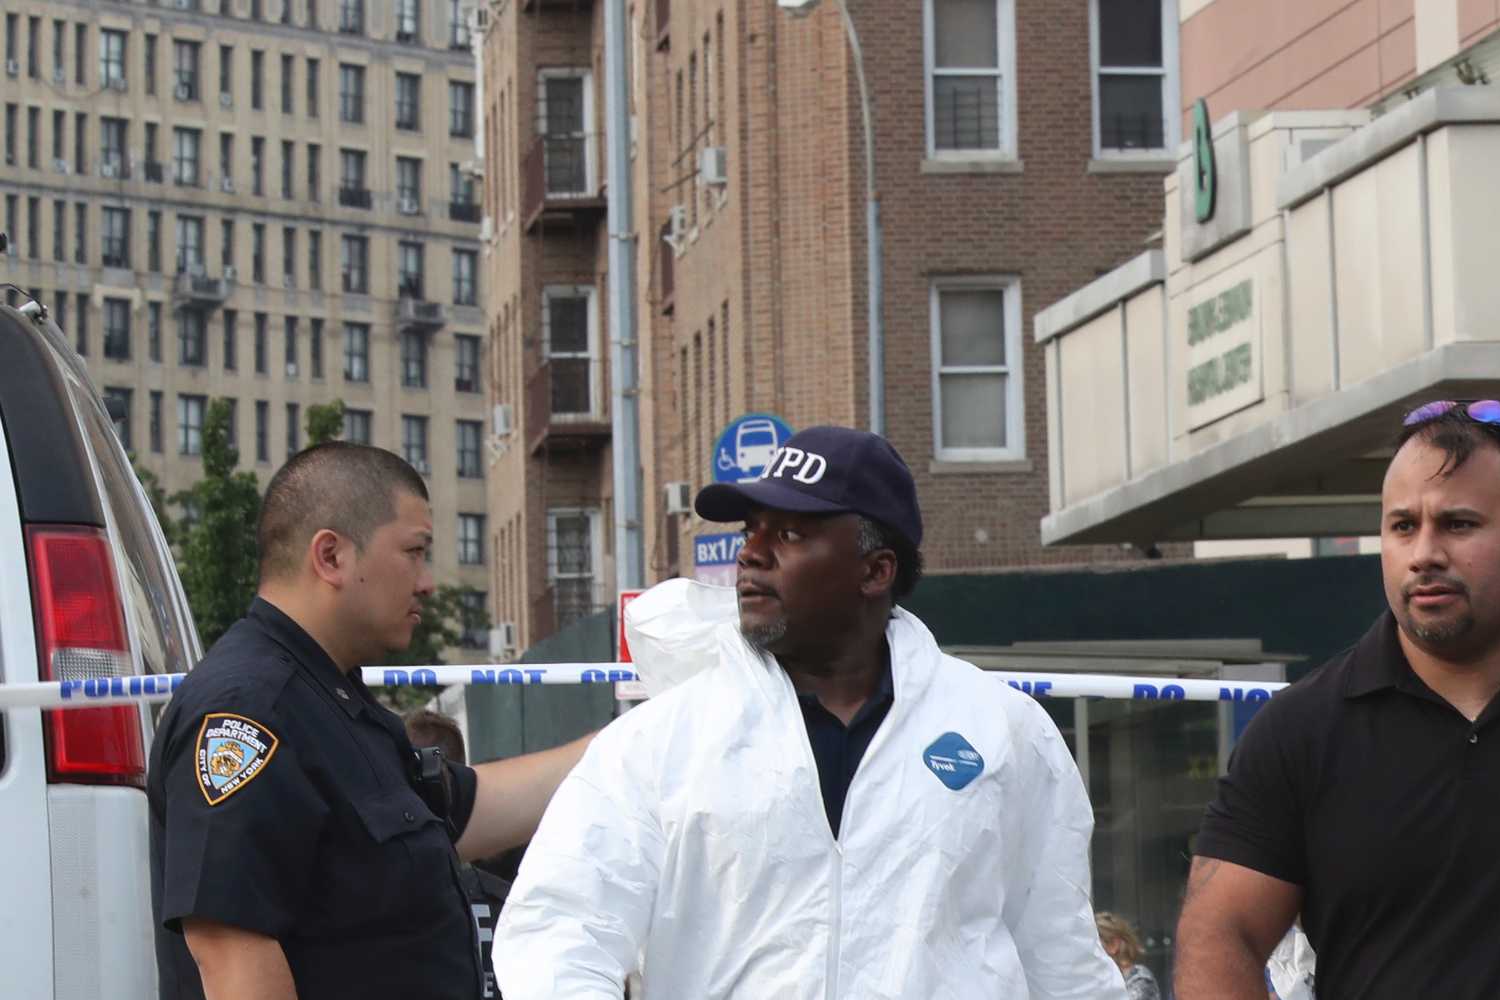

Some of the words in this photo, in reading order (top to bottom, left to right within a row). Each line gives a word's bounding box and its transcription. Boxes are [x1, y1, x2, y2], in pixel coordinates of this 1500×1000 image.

[222, 719, 260, 738] POLICE
[205, 727, 268, 754] DEPARTMENT
[199, 749, 208, 772] CITY
[202, 773, 212, 787] OF
[220, 777, 240, 794] NEW
[239, 757, 264, 779] YORK
